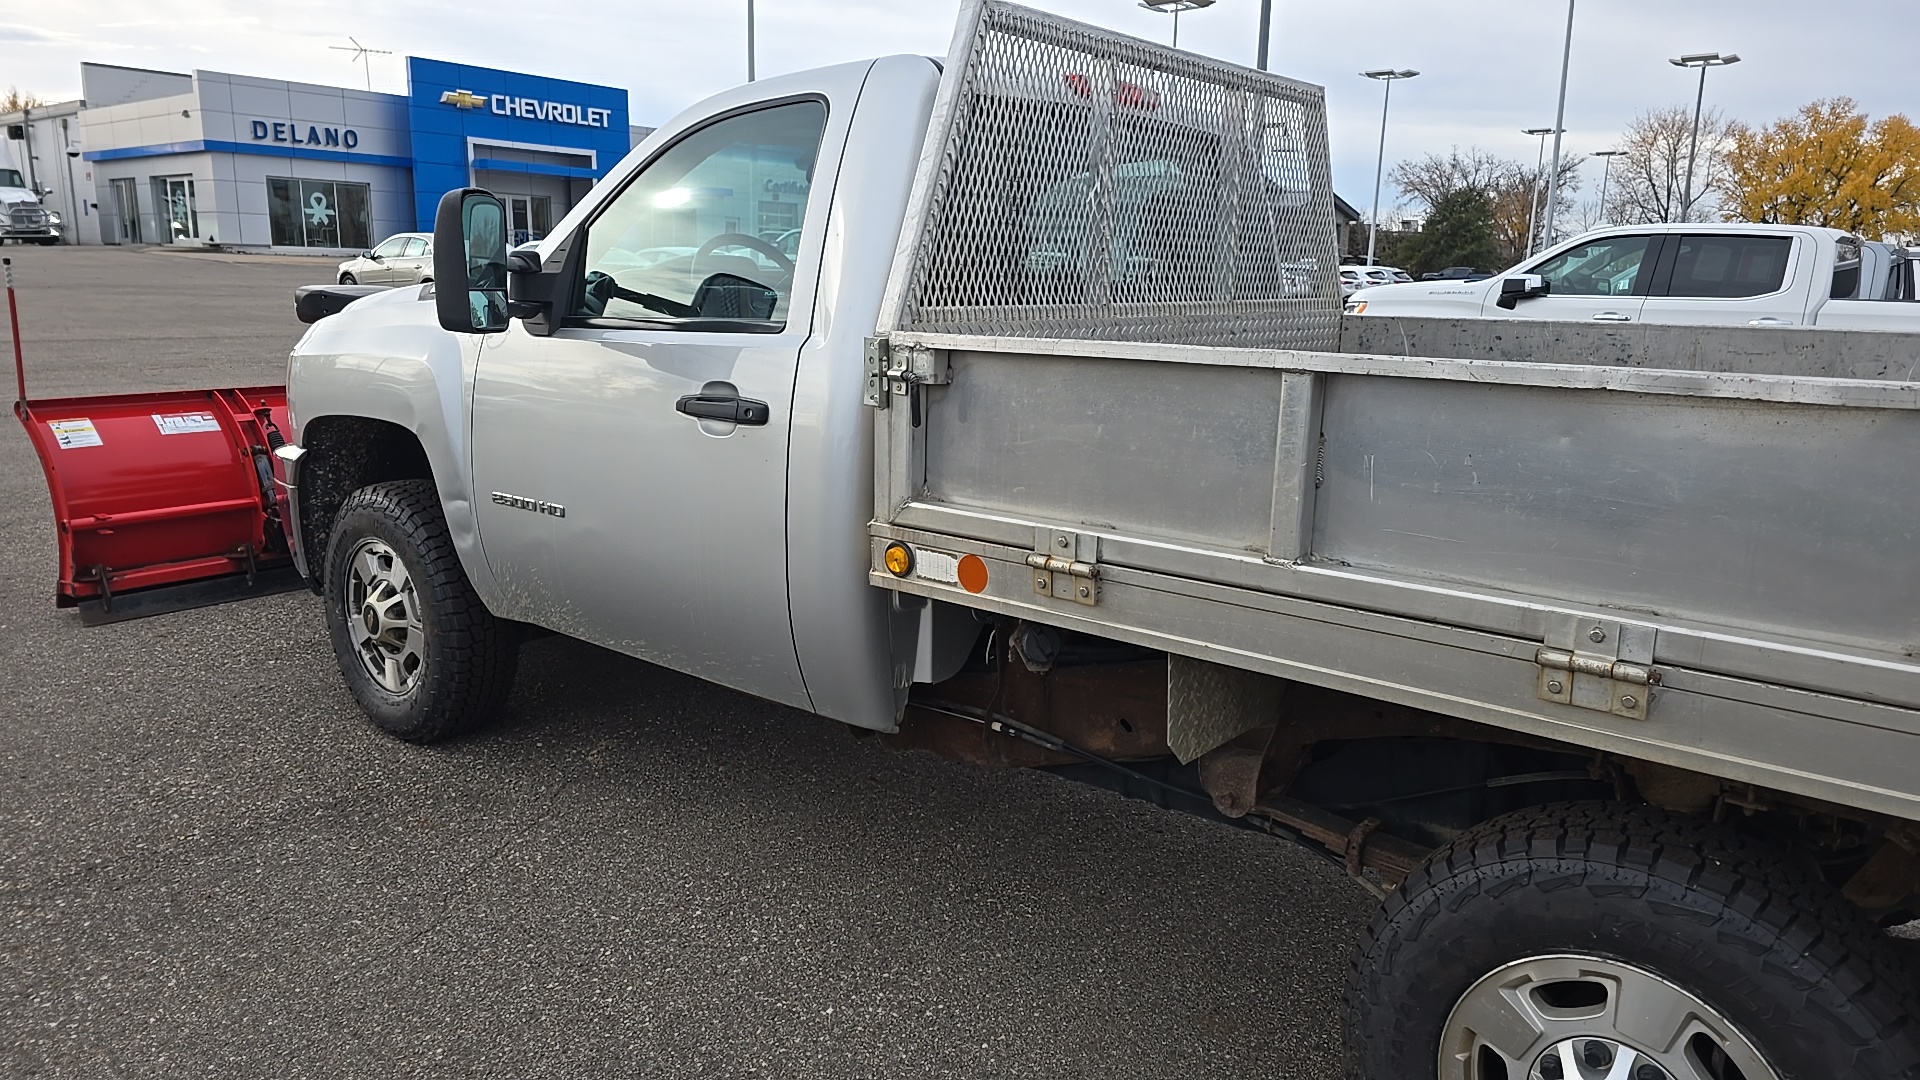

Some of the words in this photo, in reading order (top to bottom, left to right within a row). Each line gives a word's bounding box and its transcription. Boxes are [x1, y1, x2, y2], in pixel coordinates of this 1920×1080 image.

[491, 94, 612, 128] CHEVROLET
[251, 120, 358, 149] DELANO
[491, 490, 537, 512] 2500
[539, 500, 566, 518] HD
